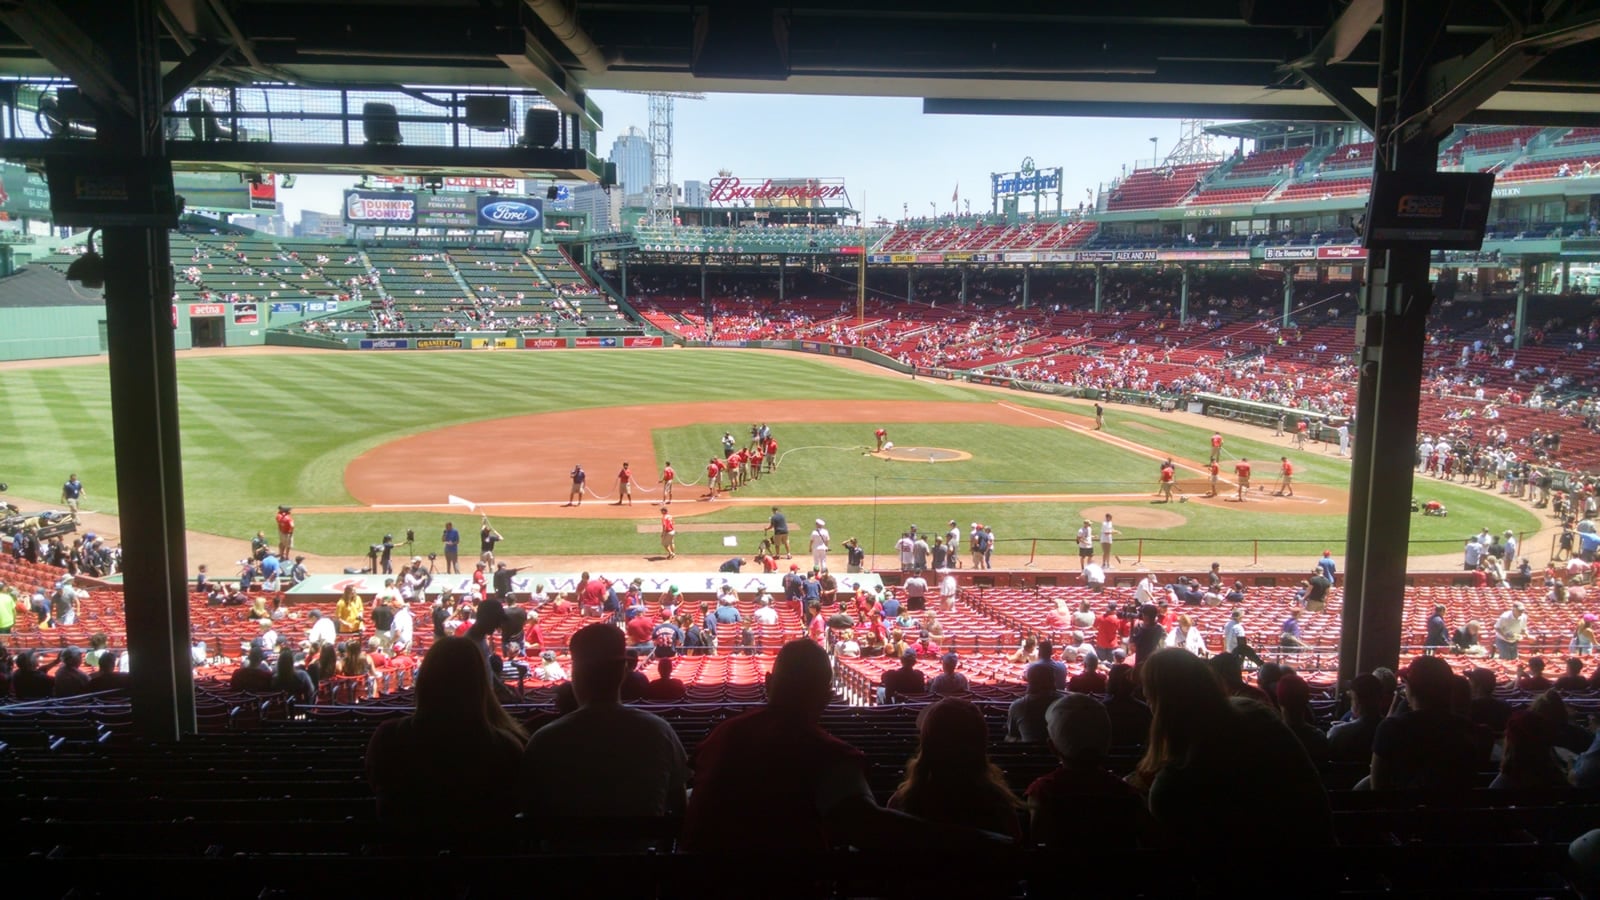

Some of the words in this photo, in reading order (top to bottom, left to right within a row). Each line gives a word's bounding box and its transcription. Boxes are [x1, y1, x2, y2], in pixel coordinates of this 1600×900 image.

[709, 177, 844, 202] Budweiser
[365, 199, 414, 210] DUNKIN'
[365, 209, 412, 220] DONUTS
[493, 204, 528, 221] Ford
[1116, 252, 1130, 260] ALEX
[1130, 251, 1144, 259] AND
[1144, 251, 1156, 259] ANI
[194, 305, 220, 315] aetna
[534, 339, 558, 349] xfinity
